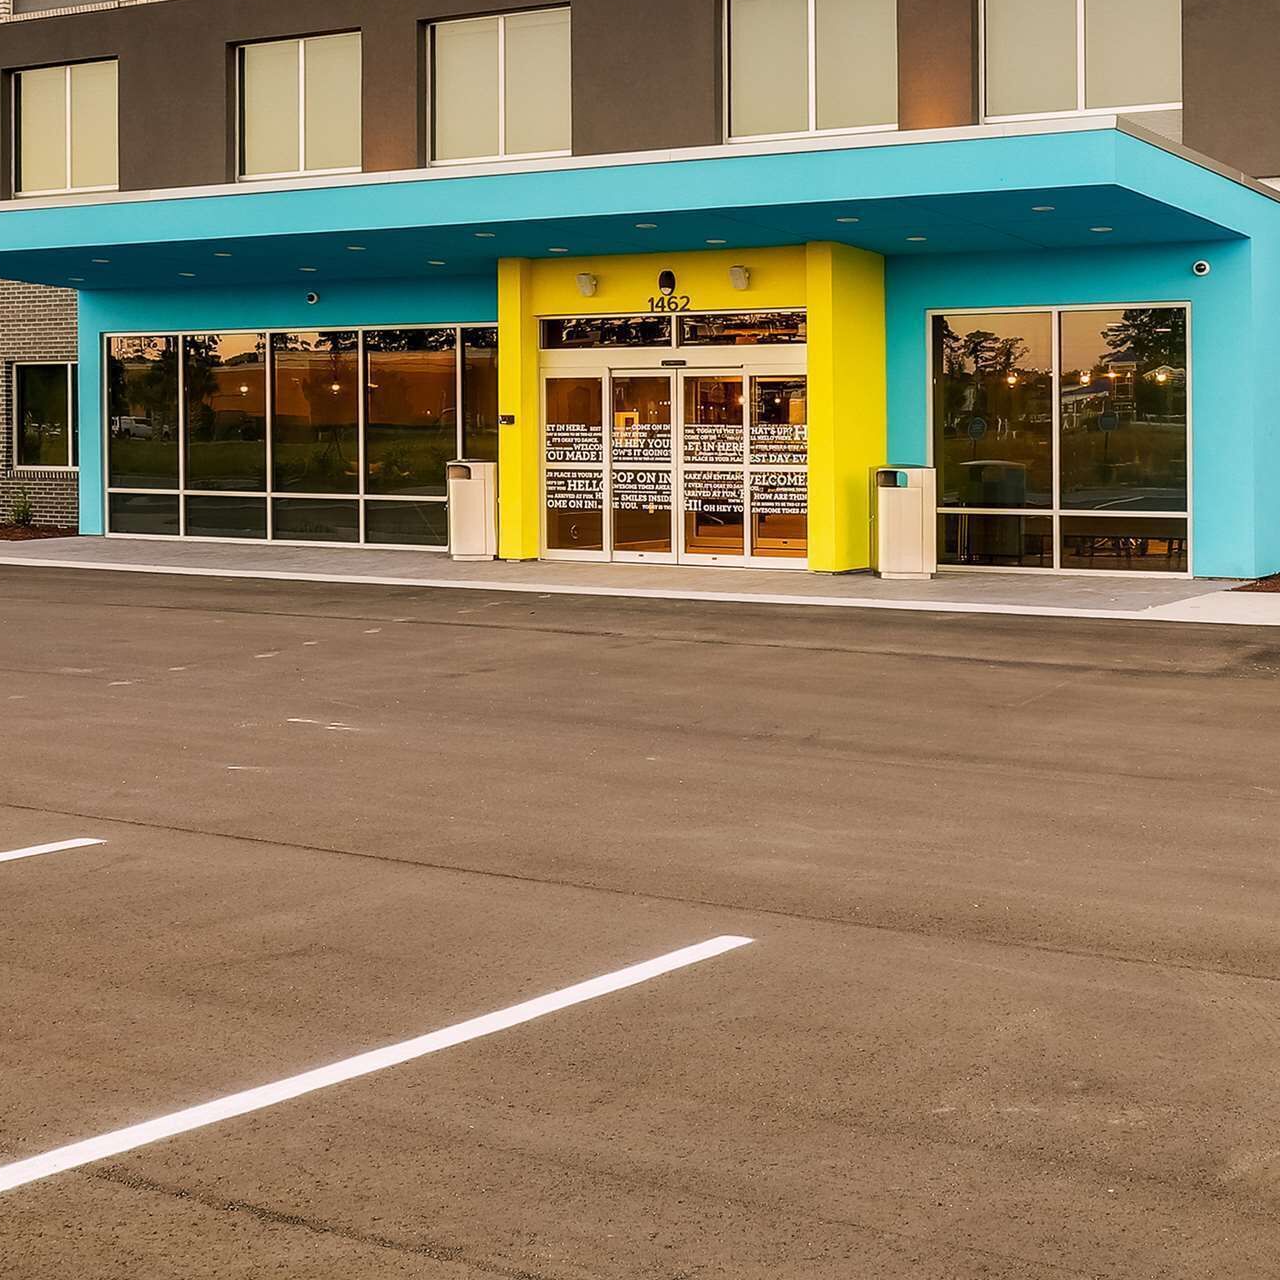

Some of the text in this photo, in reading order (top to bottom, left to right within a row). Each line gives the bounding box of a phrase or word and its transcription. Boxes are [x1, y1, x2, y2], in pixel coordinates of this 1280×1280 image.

[648, 295, 691, 312] 1462
[612, 439, 624, 448] H
[625, 439, 645, 448] HEY
[702, 441, 715, 451] IN
[546, 451, 564, 460] OU
[566, 451, 597, 460] MADE
[769, 454, 790, 463] DAY
[612, 472, 671, 483] POP ON IN
[621, 494, 647, 502] SMILES
[568, 500, 583, 508] ON
